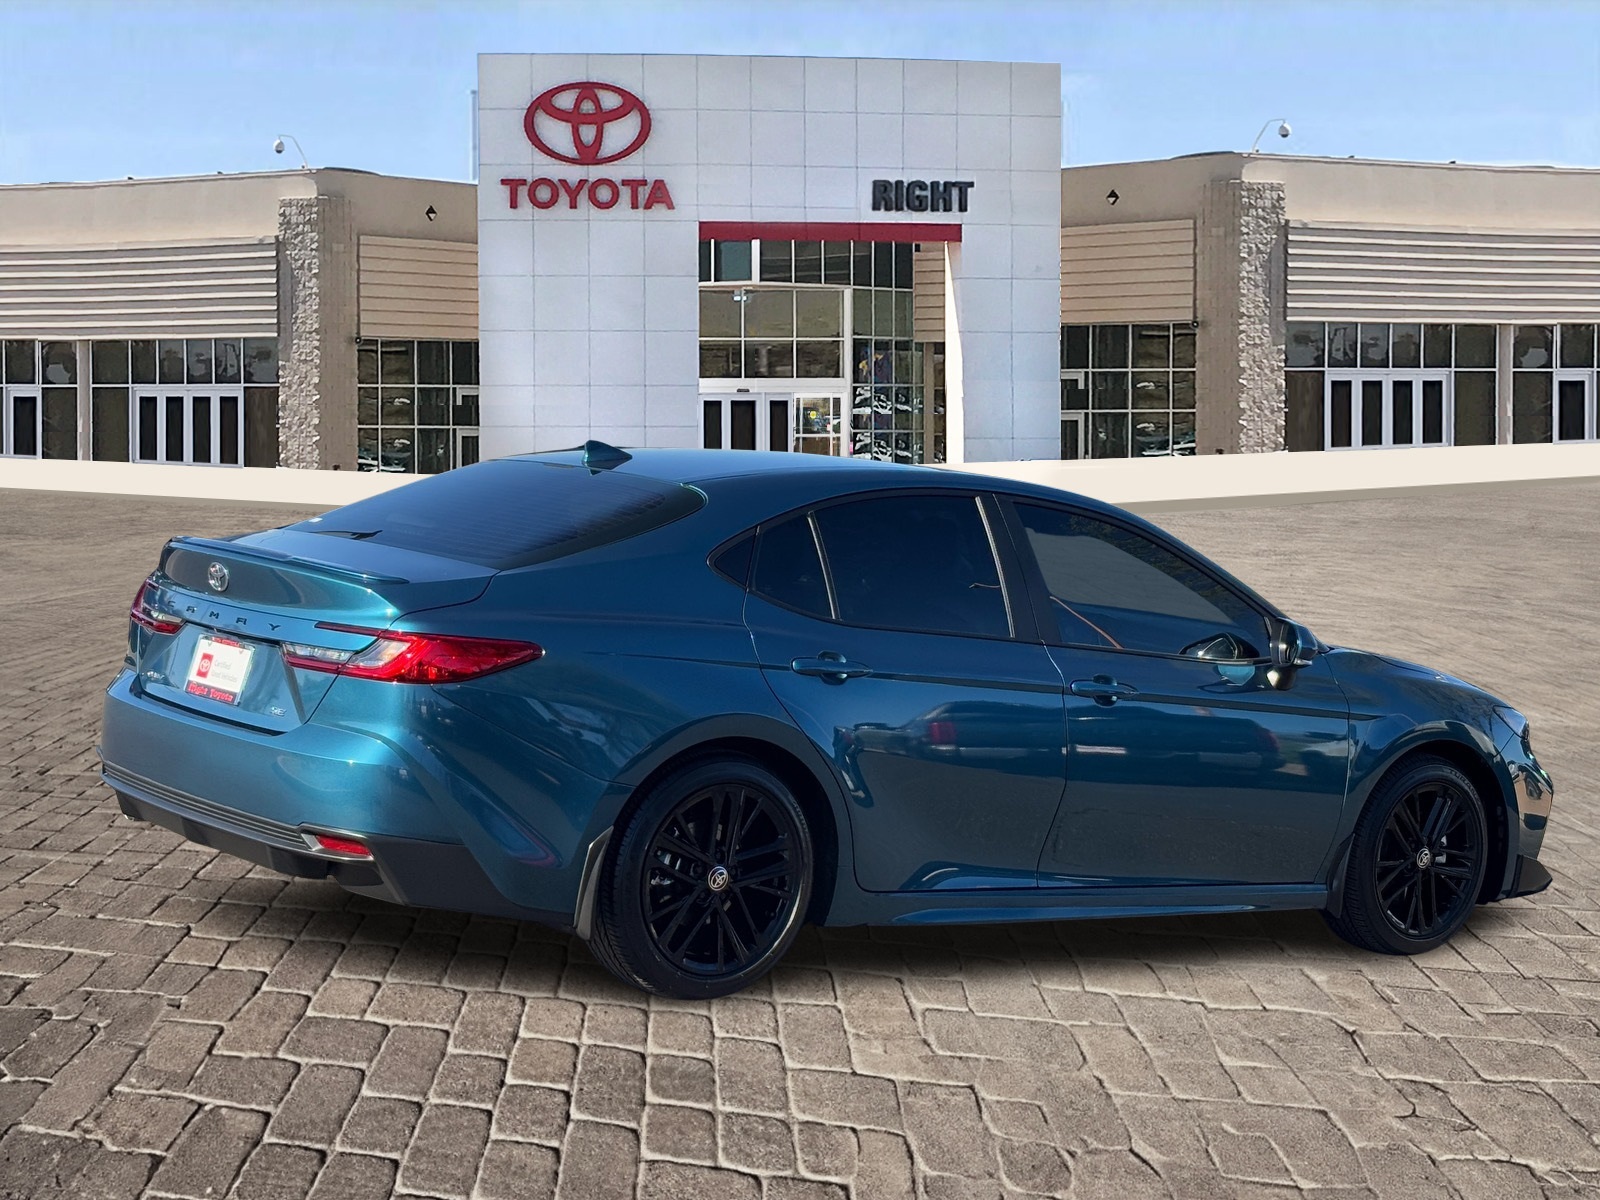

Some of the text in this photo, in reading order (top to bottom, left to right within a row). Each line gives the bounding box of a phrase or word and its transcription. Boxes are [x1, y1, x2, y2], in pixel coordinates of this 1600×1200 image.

[501, 179, 675, 210] TOYOTA
[872, 179, 975, 212] RIGHT
[167, 600, 281, 631] CAMRY
[188, 681, 234, 702] Right Toyota
